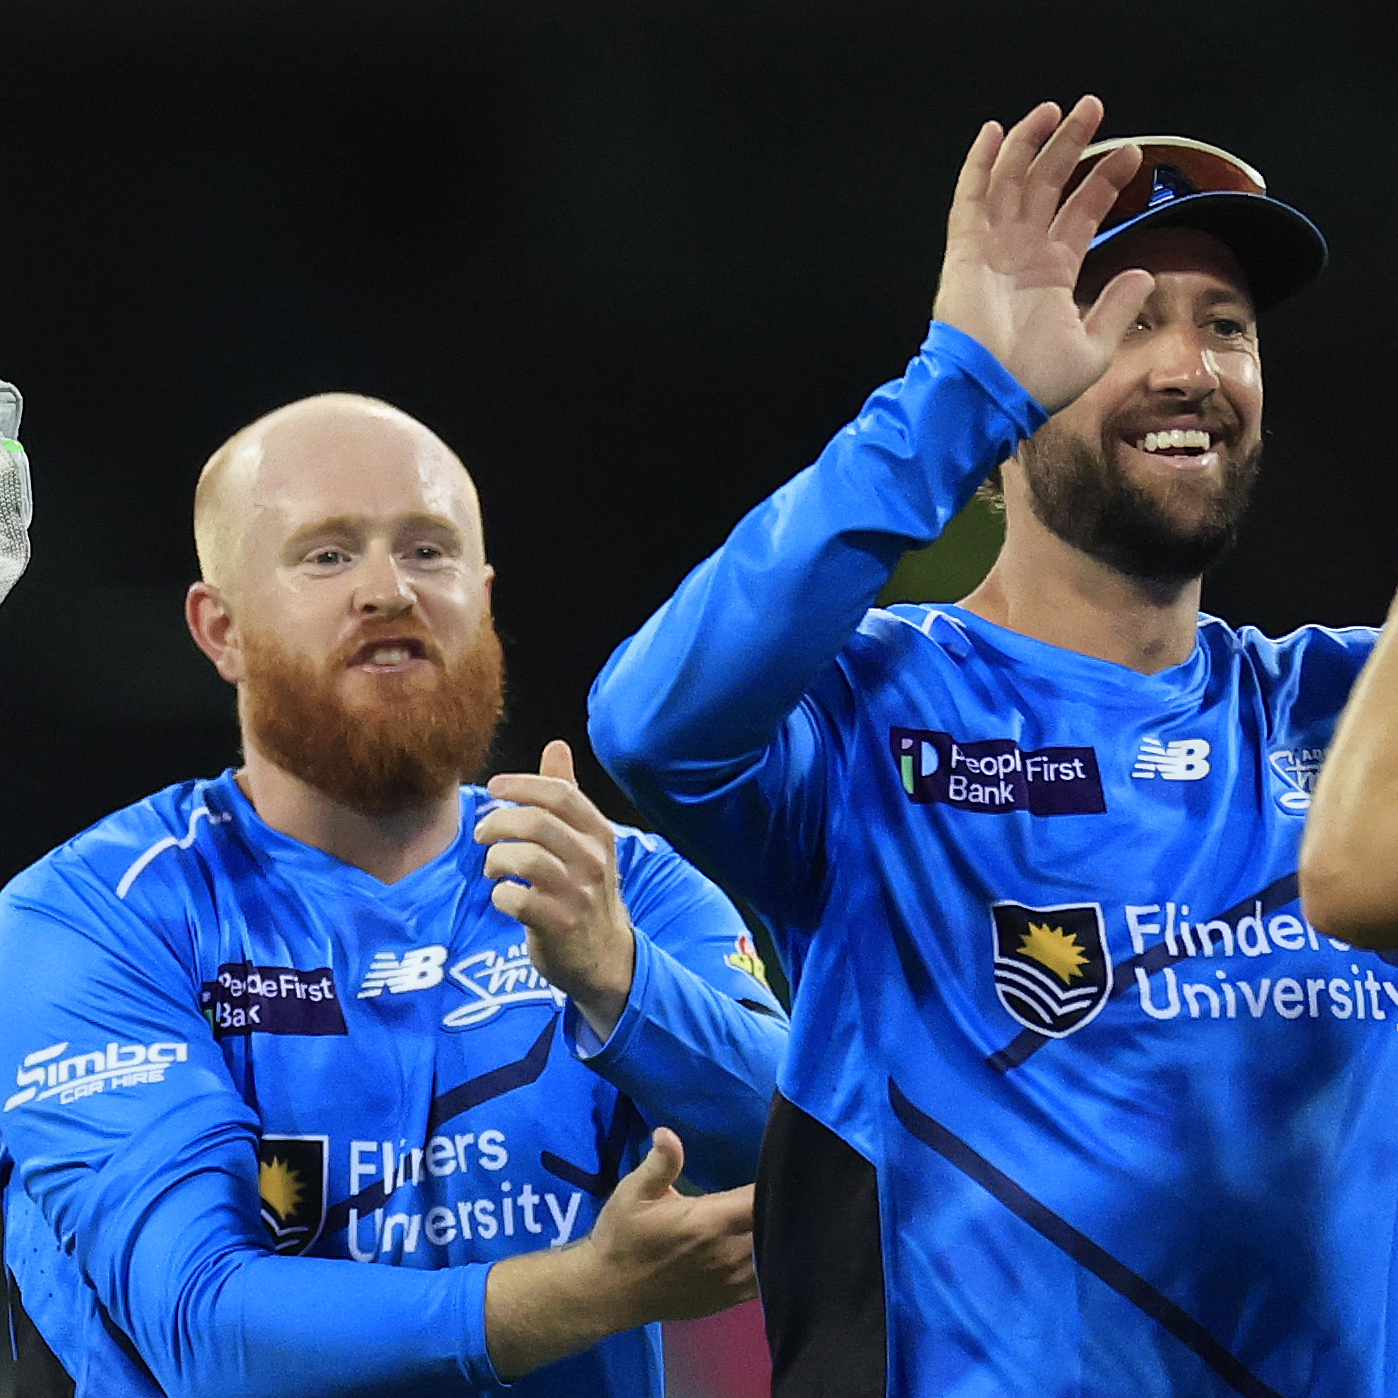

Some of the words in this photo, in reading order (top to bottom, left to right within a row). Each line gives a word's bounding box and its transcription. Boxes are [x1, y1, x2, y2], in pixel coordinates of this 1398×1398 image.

[1025, 756, 1087, 782] First
[949, 775, 1015, 805] Bank
[279, 974, 334, 1002] First
[3, 1041, 189, 1112] Simba
[59, 1081, 105, 1105] CAR
[111, 1069, 166, 1089] HIRE
